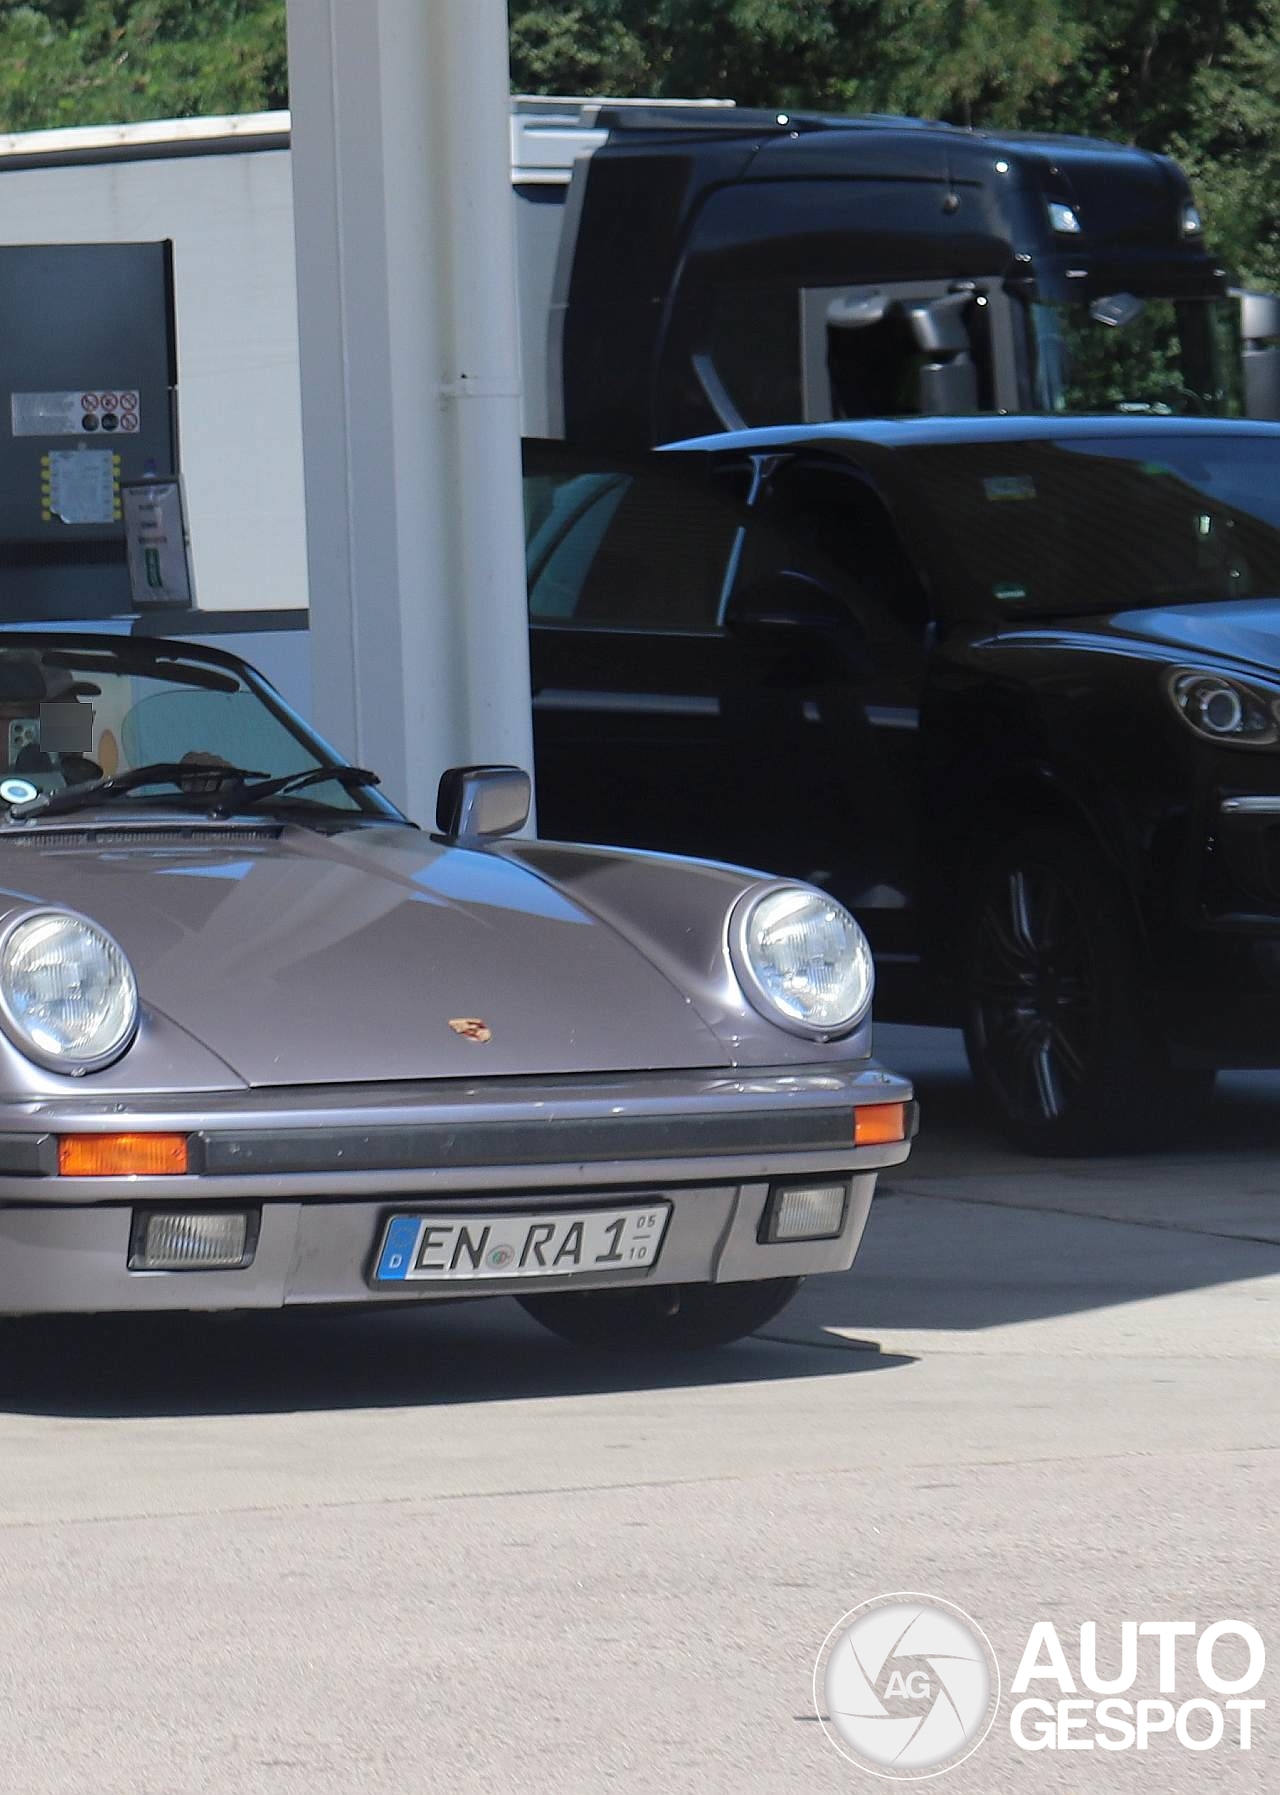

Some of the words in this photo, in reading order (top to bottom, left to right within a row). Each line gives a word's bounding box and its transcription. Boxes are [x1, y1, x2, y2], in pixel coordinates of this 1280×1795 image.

[636, 1214, 657, 1229] 05
[413, 1225, 492, 1271] EN
[518, 1221, 585, 1269] RA
[595, 1217, 627, 1263] 1
[629, 1246, 648, 1260] 10
[388, 1254, 403, 1269] D
